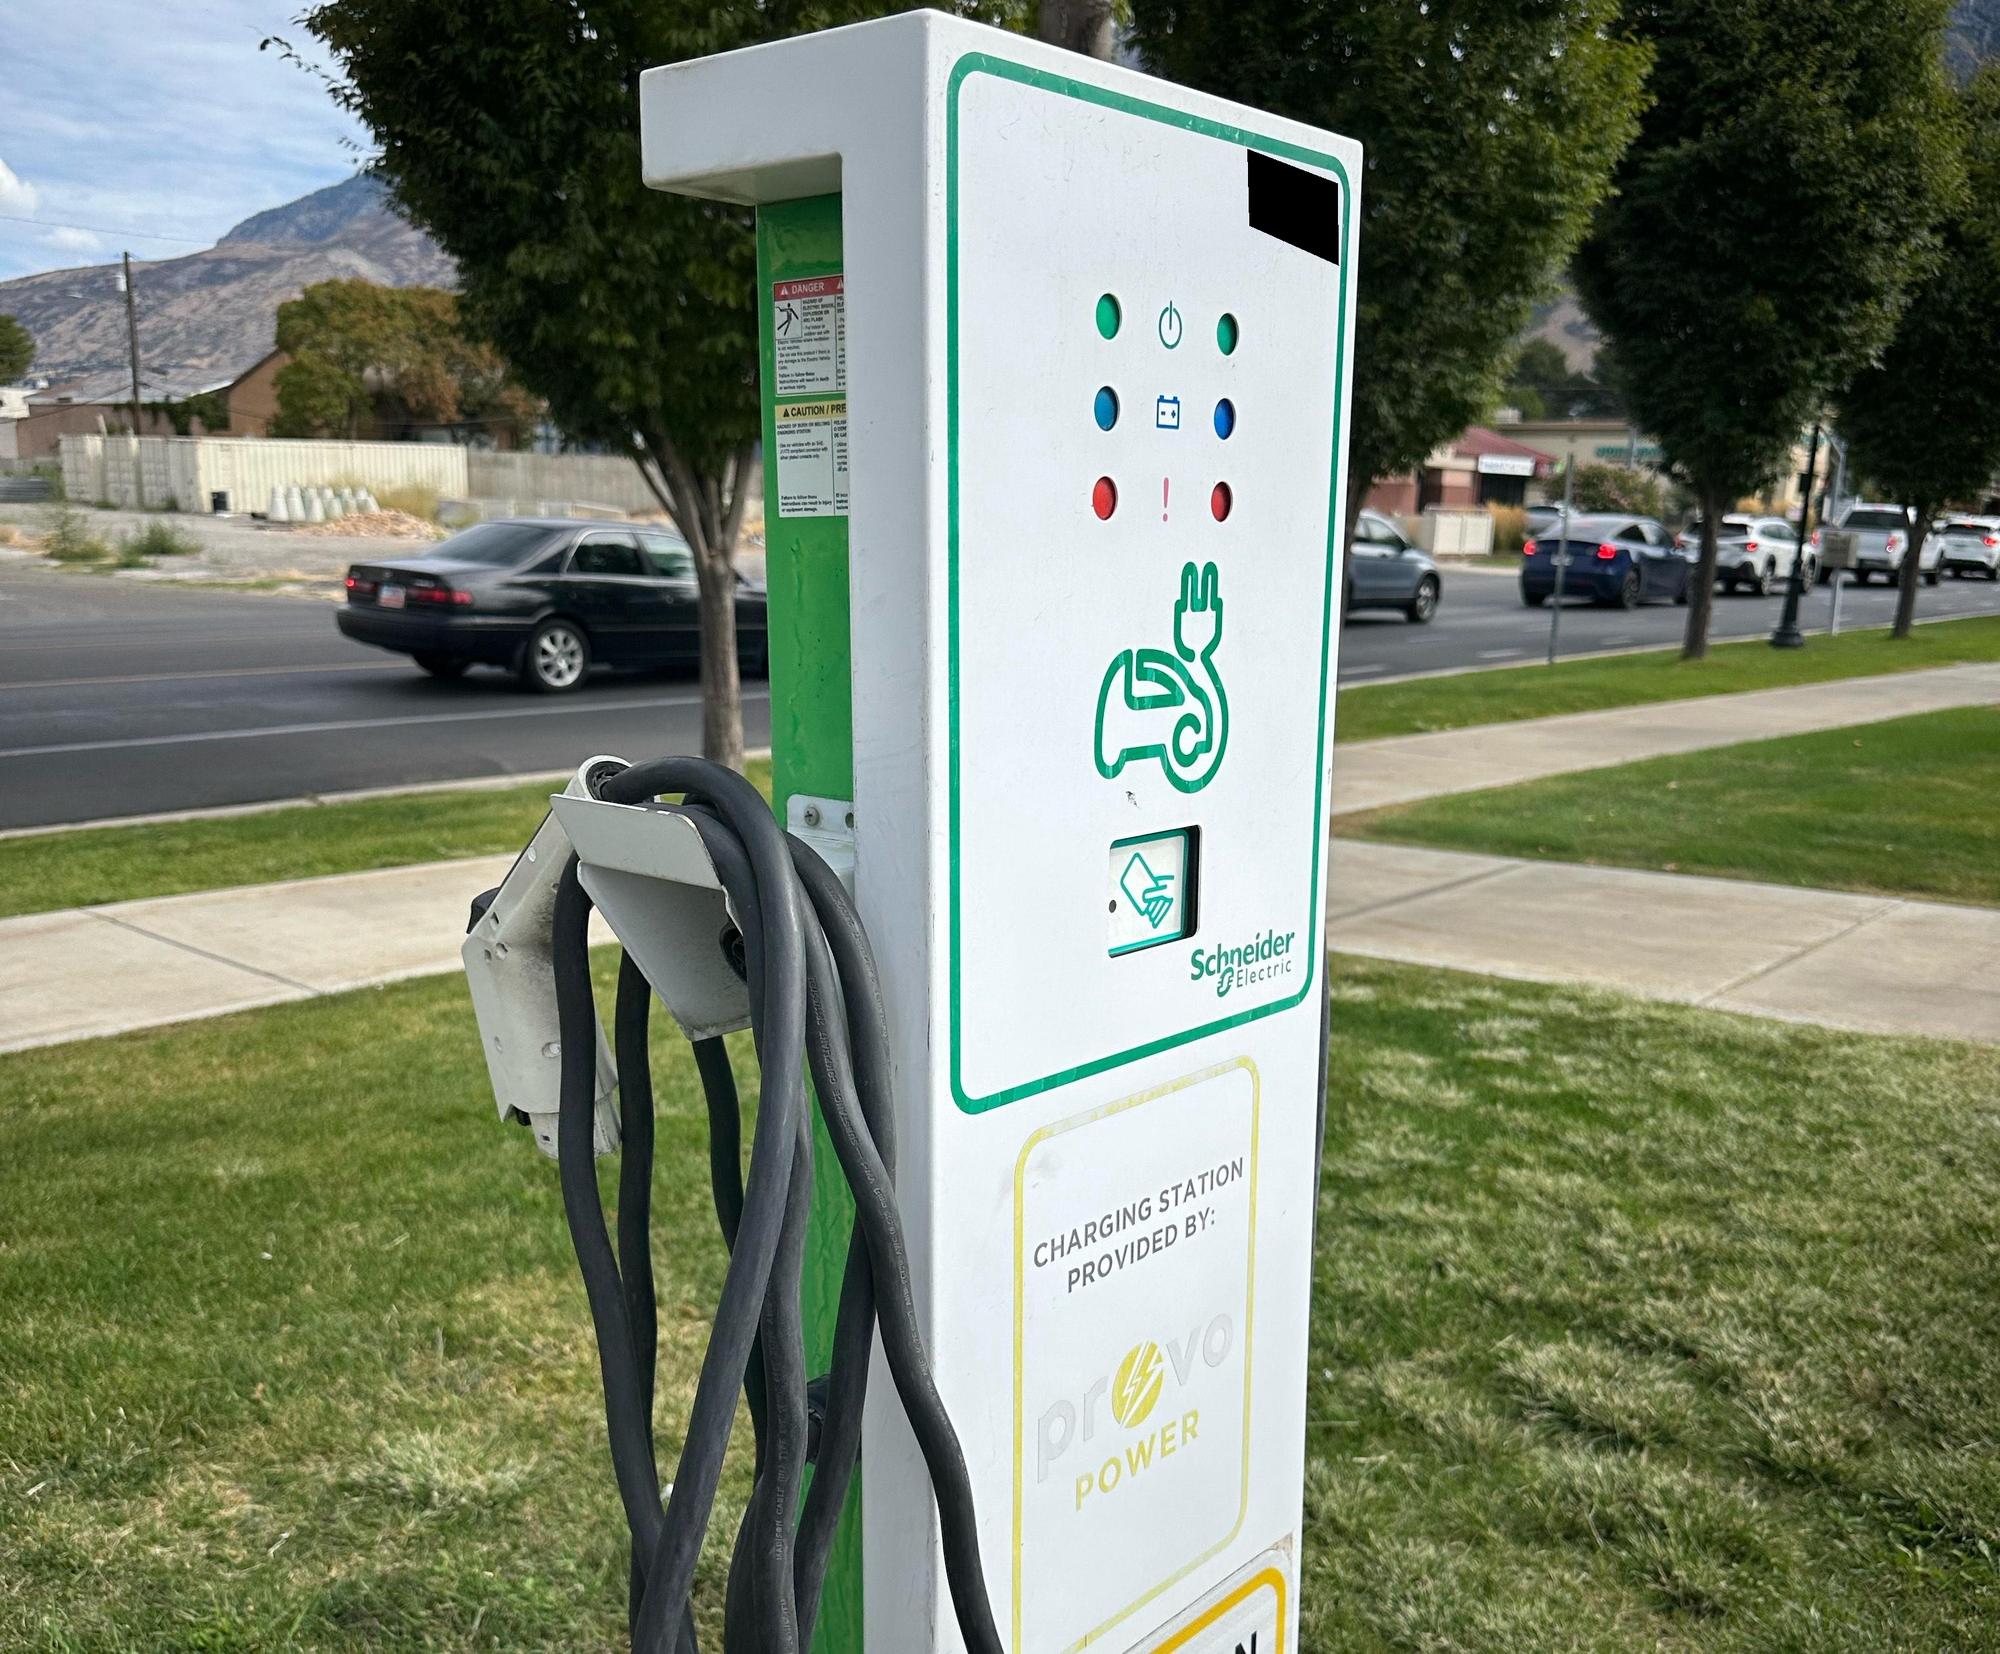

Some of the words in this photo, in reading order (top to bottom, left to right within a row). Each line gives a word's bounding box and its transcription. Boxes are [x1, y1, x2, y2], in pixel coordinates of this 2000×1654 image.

[791, 282, 825, 294] DANGER
[790, 404, 825, 417] CAUTION
[826, 405, 830, 415] /
[1190, 929, 1295, 981] Schneider
[1236, 958, 1292, 988] Electric
[1033, 1197, 1152, 1268] CHARGING
[1159, 1157, 1244, 1213] STATION
[1067, 1224, 1178, 1293] PROVIDED
[1185, 1207, 1215, 1239] BY:
[1075, 1408, 1200, 1512] POWER
